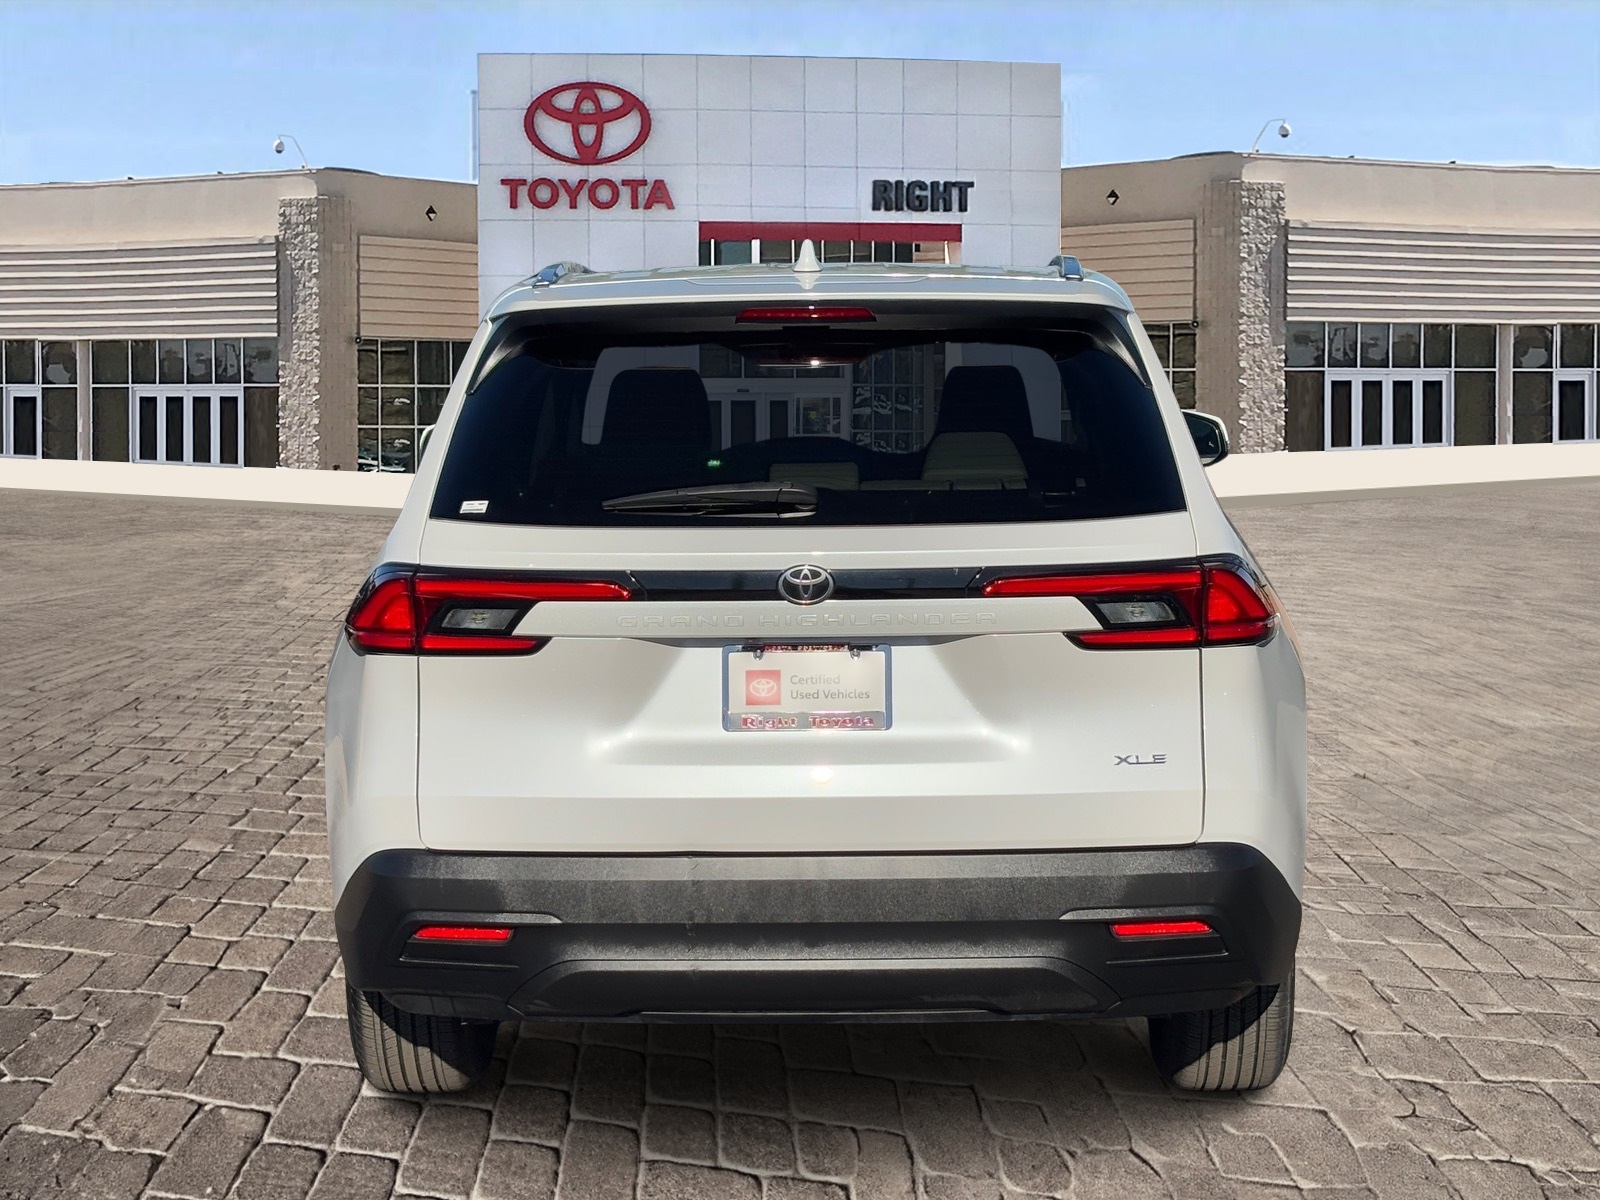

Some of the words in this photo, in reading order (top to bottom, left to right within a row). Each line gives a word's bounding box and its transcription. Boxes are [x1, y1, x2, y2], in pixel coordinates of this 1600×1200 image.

[500, 178, 675, 209] TOYOTA
[871, 179, 975, 212] RIGHT
[615, 613, 745, 629] GRAND
[758, 611, 998, 628] HIGHLANDER
[790, 674, 841, 685] Certified
[790, 689, 820, 700] Used
[822, 689, 870, 699] Vehicles
[741, 715, 798, 729] Right
[808, 715, 875, 728] Toyota
[1113, 753, 1167, 766] XLE
